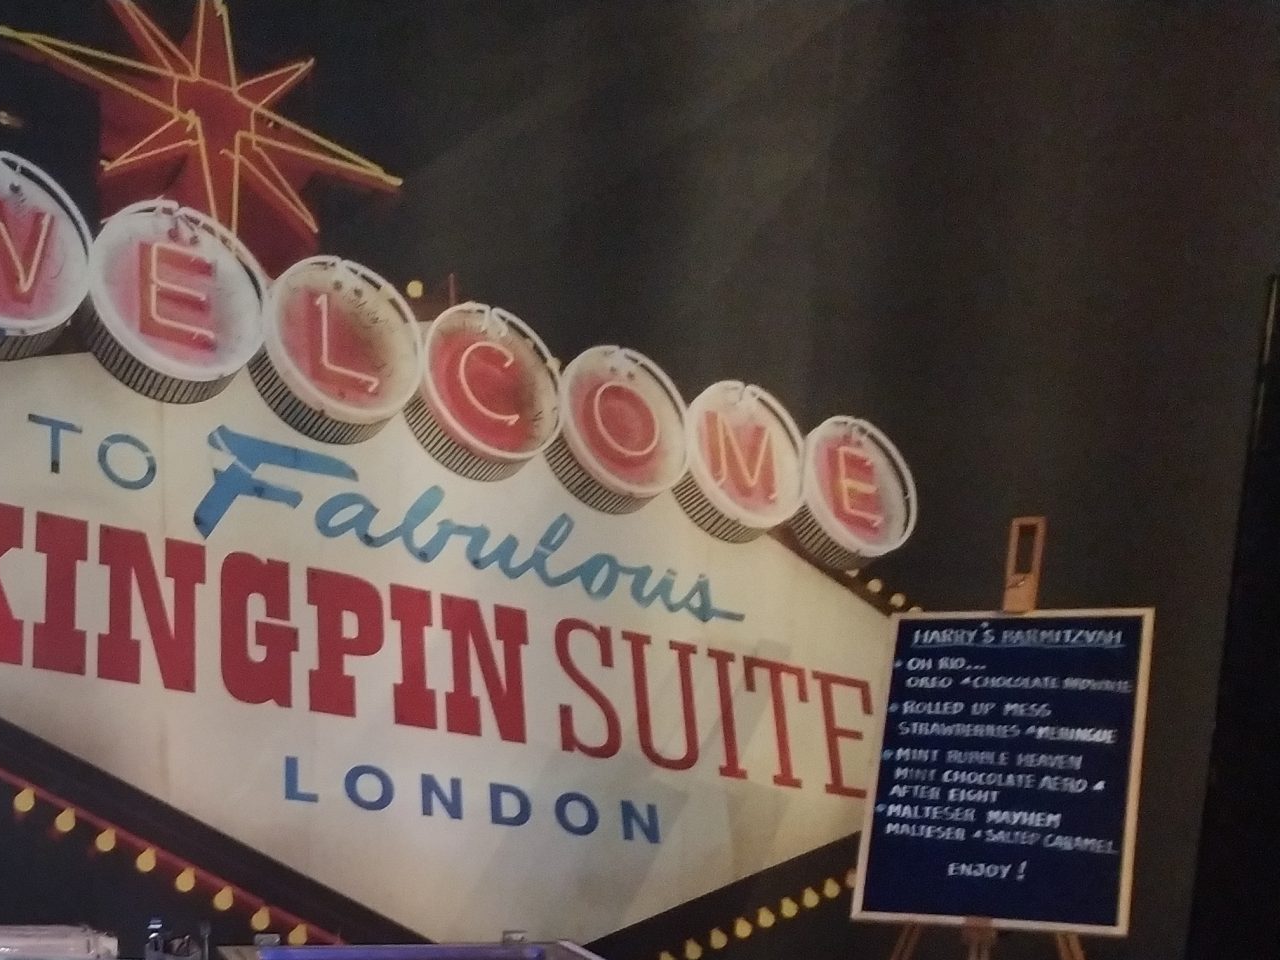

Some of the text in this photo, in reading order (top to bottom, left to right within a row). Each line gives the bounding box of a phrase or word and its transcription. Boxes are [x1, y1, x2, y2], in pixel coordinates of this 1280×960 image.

[27, 413, 744, 623] TO Fabulous
[906, 657, 932, 671] OH
[905, 676, 953, 688] OREO
[972, 676, 1059, 689] CHOCOLATE
[553, 616, 875, 798] SUITE
[901, 701, 1052, 718] ROLLED UP MESS
[898, 721, 1020, 738] STRAWBERRIES
[895, 748, 938, 762] MINT
[1016, 753, 1083, 770] HEAVEN
[942, 769, 1036, 788] CHOCOLATE
[1039, 776, 1088, 794] AERO
[283, 756, 662, 845] LONDON
[889, 784, 1000, 803] AFTER EIGHT
[886, 804, 1062, 829] MALTESER MAYHEM
[885, 822, 966, 841] MALTESER
[947, 862, 1012, 879] ENJOY
